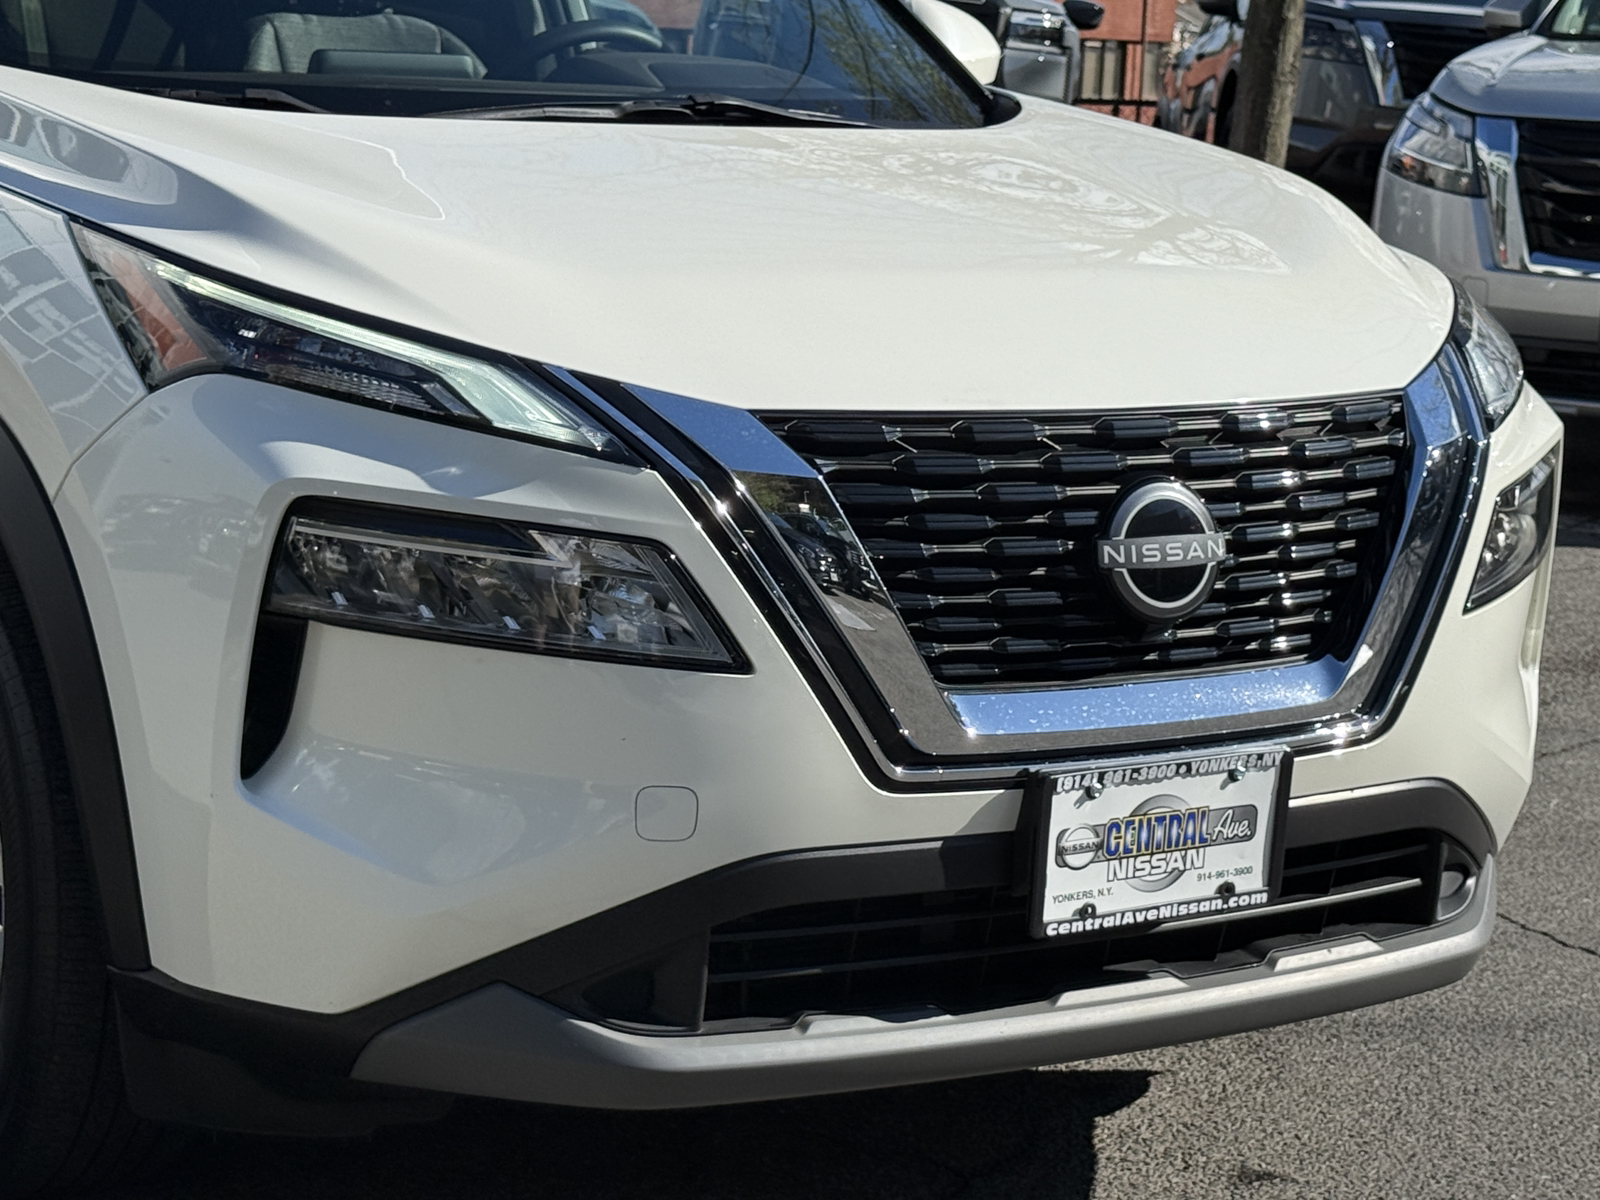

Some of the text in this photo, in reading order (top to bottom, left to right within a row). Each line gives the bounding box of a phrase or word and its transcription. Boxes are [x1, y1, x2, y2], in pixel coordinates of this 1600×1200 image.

[1103, 538, 1225, 564] NISSAN
[1104, 807, 1252, 859] CENTRAL Ave.
[1061, 841, 1099, 854] NISSAN
[1106, 848, 1206, 882] NISSAN
[1196, 866, 1253, 882] 914-961-3900
[1052, 889, 1096, 904] YONKERS,
